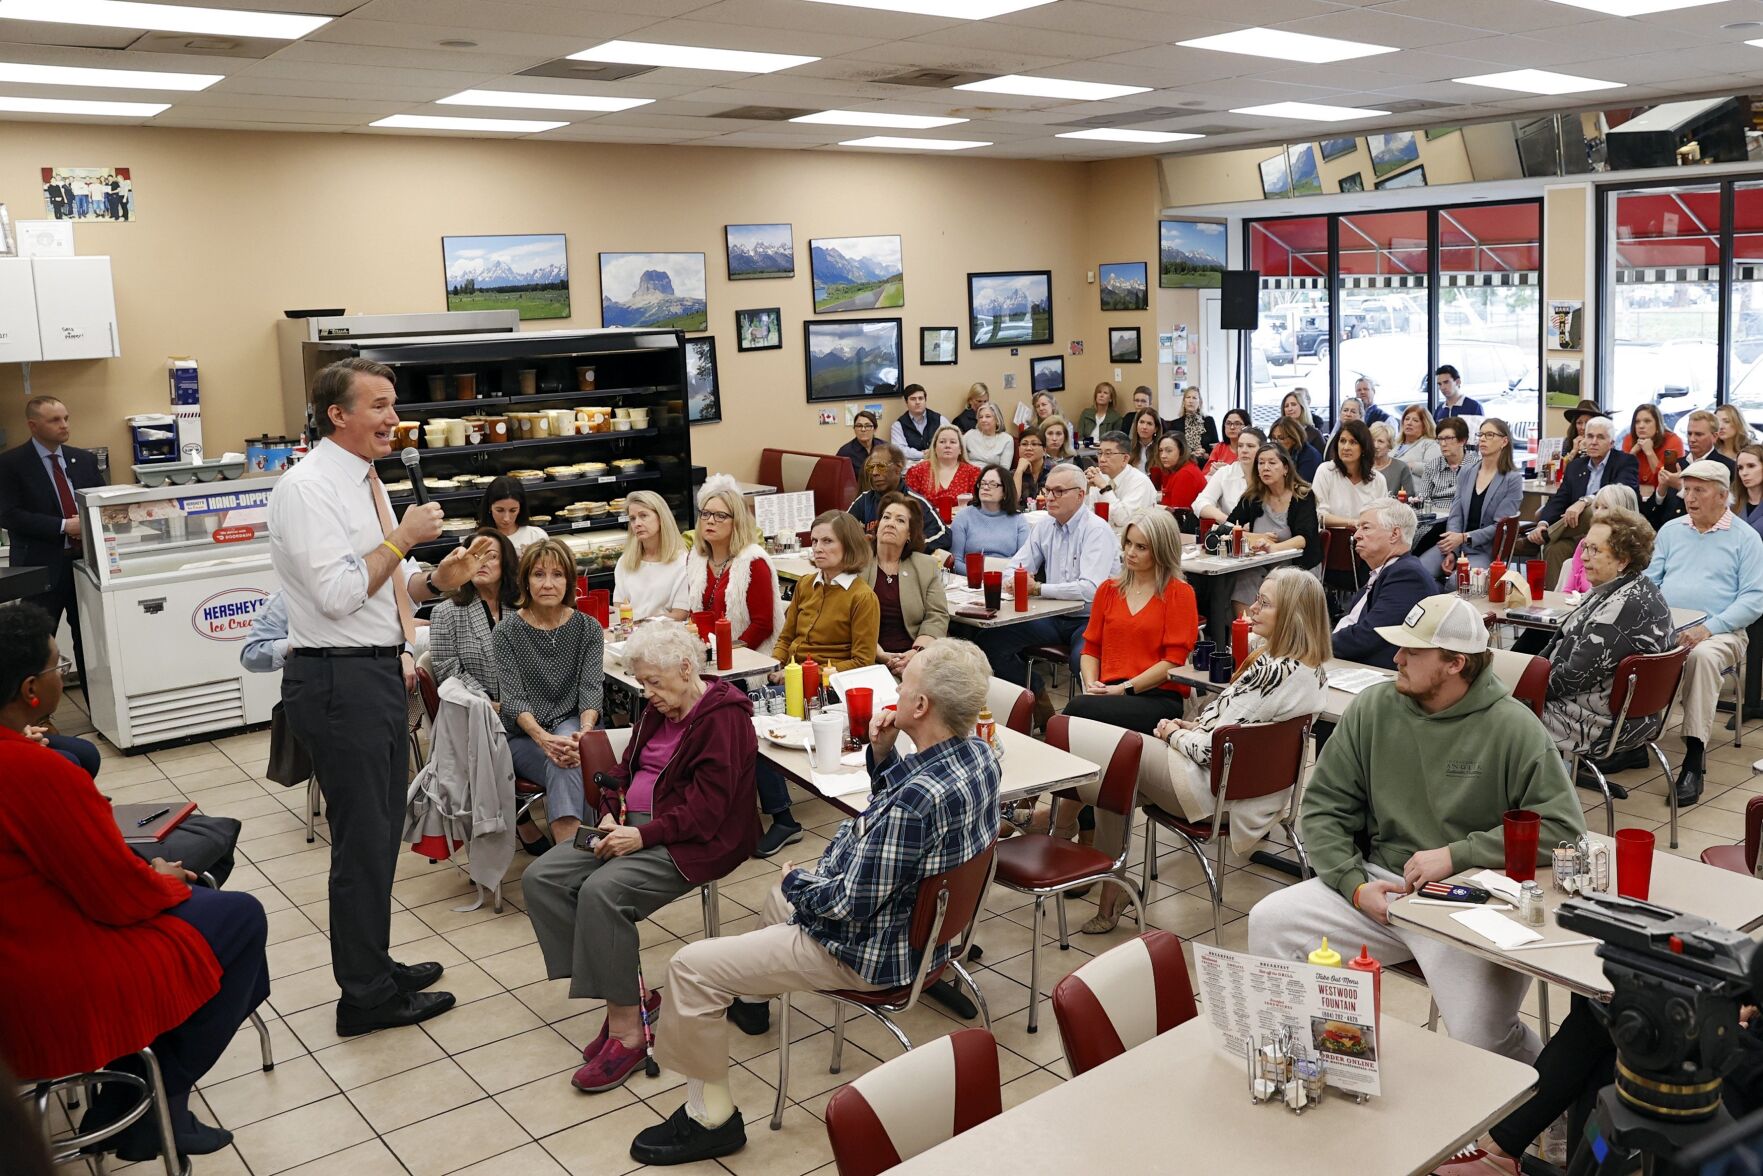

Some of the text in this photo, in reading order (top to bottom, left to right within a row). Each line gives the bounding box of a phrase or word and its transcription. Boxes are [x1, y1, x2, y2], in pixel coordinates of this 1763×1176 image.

[208, 491, 272, 510] HAND-DIPPE
[203, 598, 264, 621] HERSHEY'
[209, 621, 226, 633] Ice
[1318, 984, 1358, 1000] WESTWOOD
[1321, 996, 1357, 1012] FOUNTAIN
[1346, 1057, 1376, 1069] ONLINE
